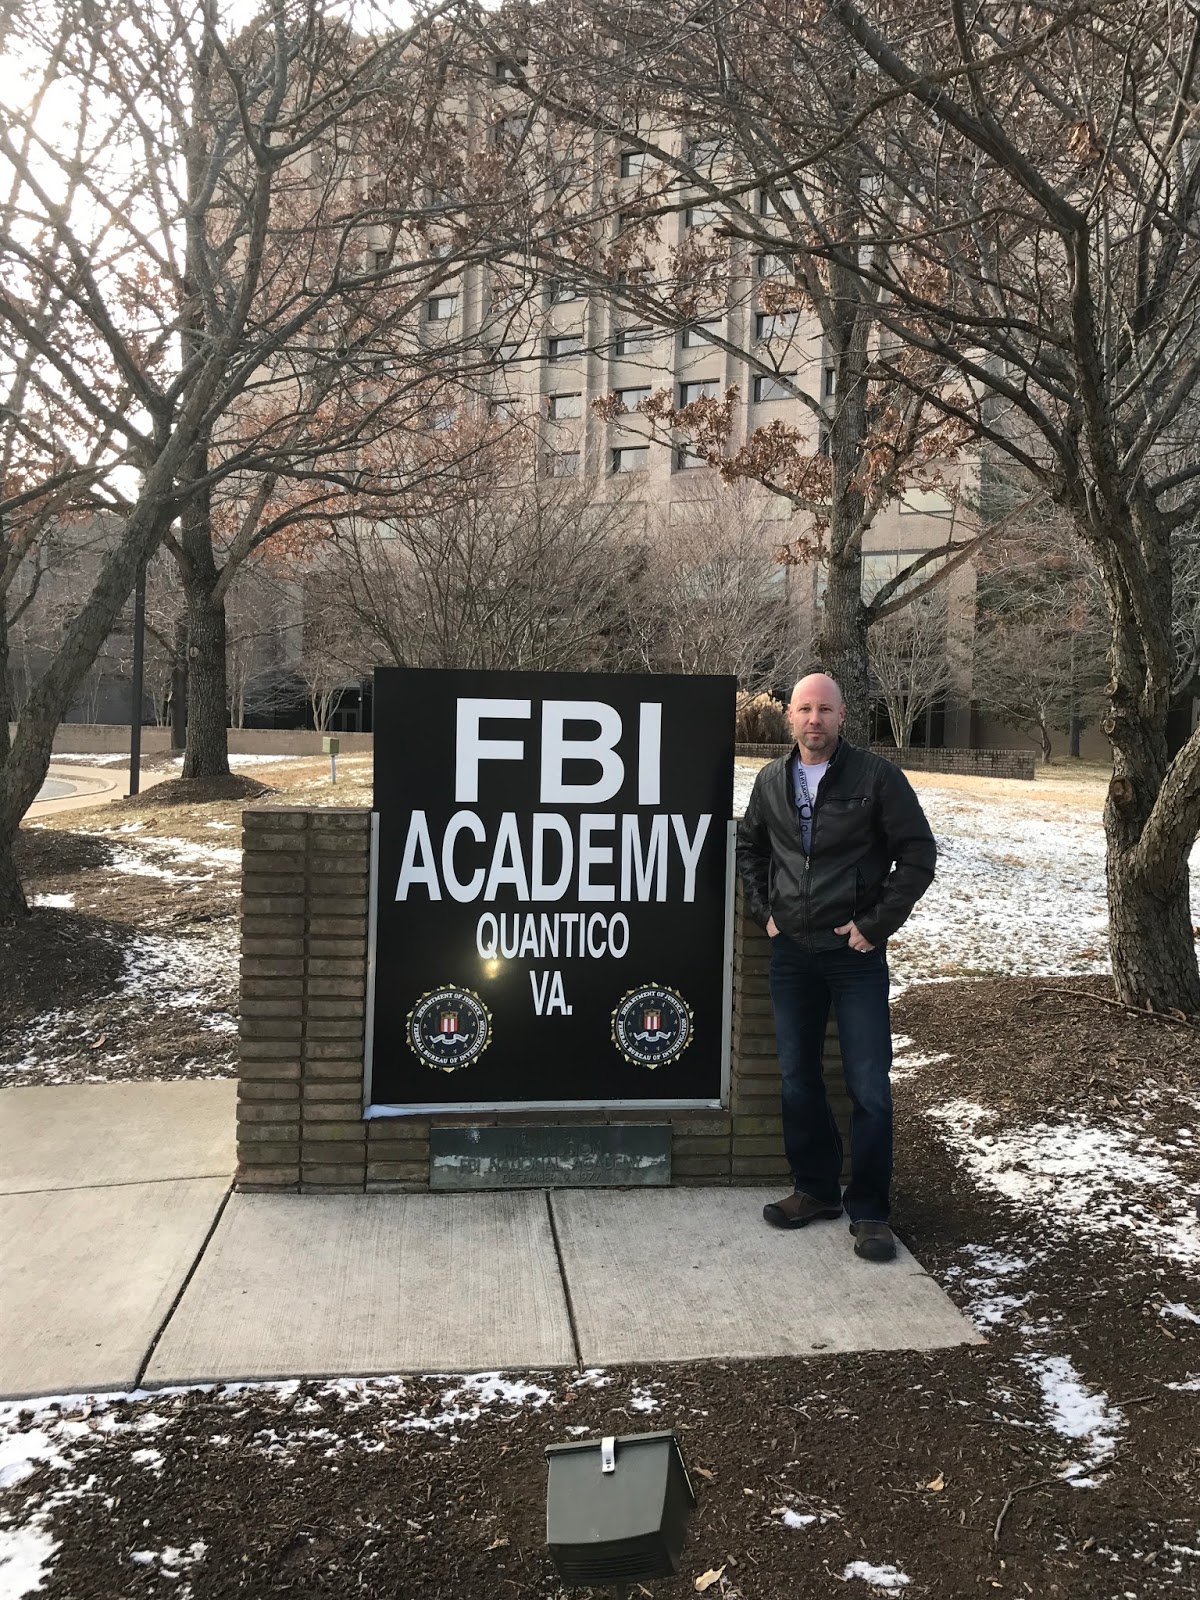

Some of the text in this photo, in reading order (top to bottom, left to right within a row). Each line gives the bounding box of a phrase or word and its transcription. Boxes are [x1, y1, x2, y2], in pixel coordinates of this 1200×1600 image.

[455, 698, 662, 805] FBI
[395, 810, 712, 902] ACADEMY
[476, 912, 629, 959] QUANTICO
[417, 993, 453, 1018] DEPARTMENT
[462, 995, 482, 1016] JUSTICE
[529, 970, 572, 1016] VA.
[621, 991, 656, 1015] DEPARTMENT
[664, 993, 684, 1014] JUSTICE
[413, 1023, 424, 1051] FEDERAL
[423, 1050, 448, 1063] BUREAU
[460, 1020, 485, 1061] INVESTIGATION
[618, 1020, 629, 1049] FEDERAL
[627, 1047, 651, 1060] BUREAU
[662, 1018, 687, 1058] INVESTIGATION
[460, 1158, 481, 1173] FBI
[490, 1156, 565, 1173] NATIONAL
[502, 1173, 556, 1184] DECEMBER
